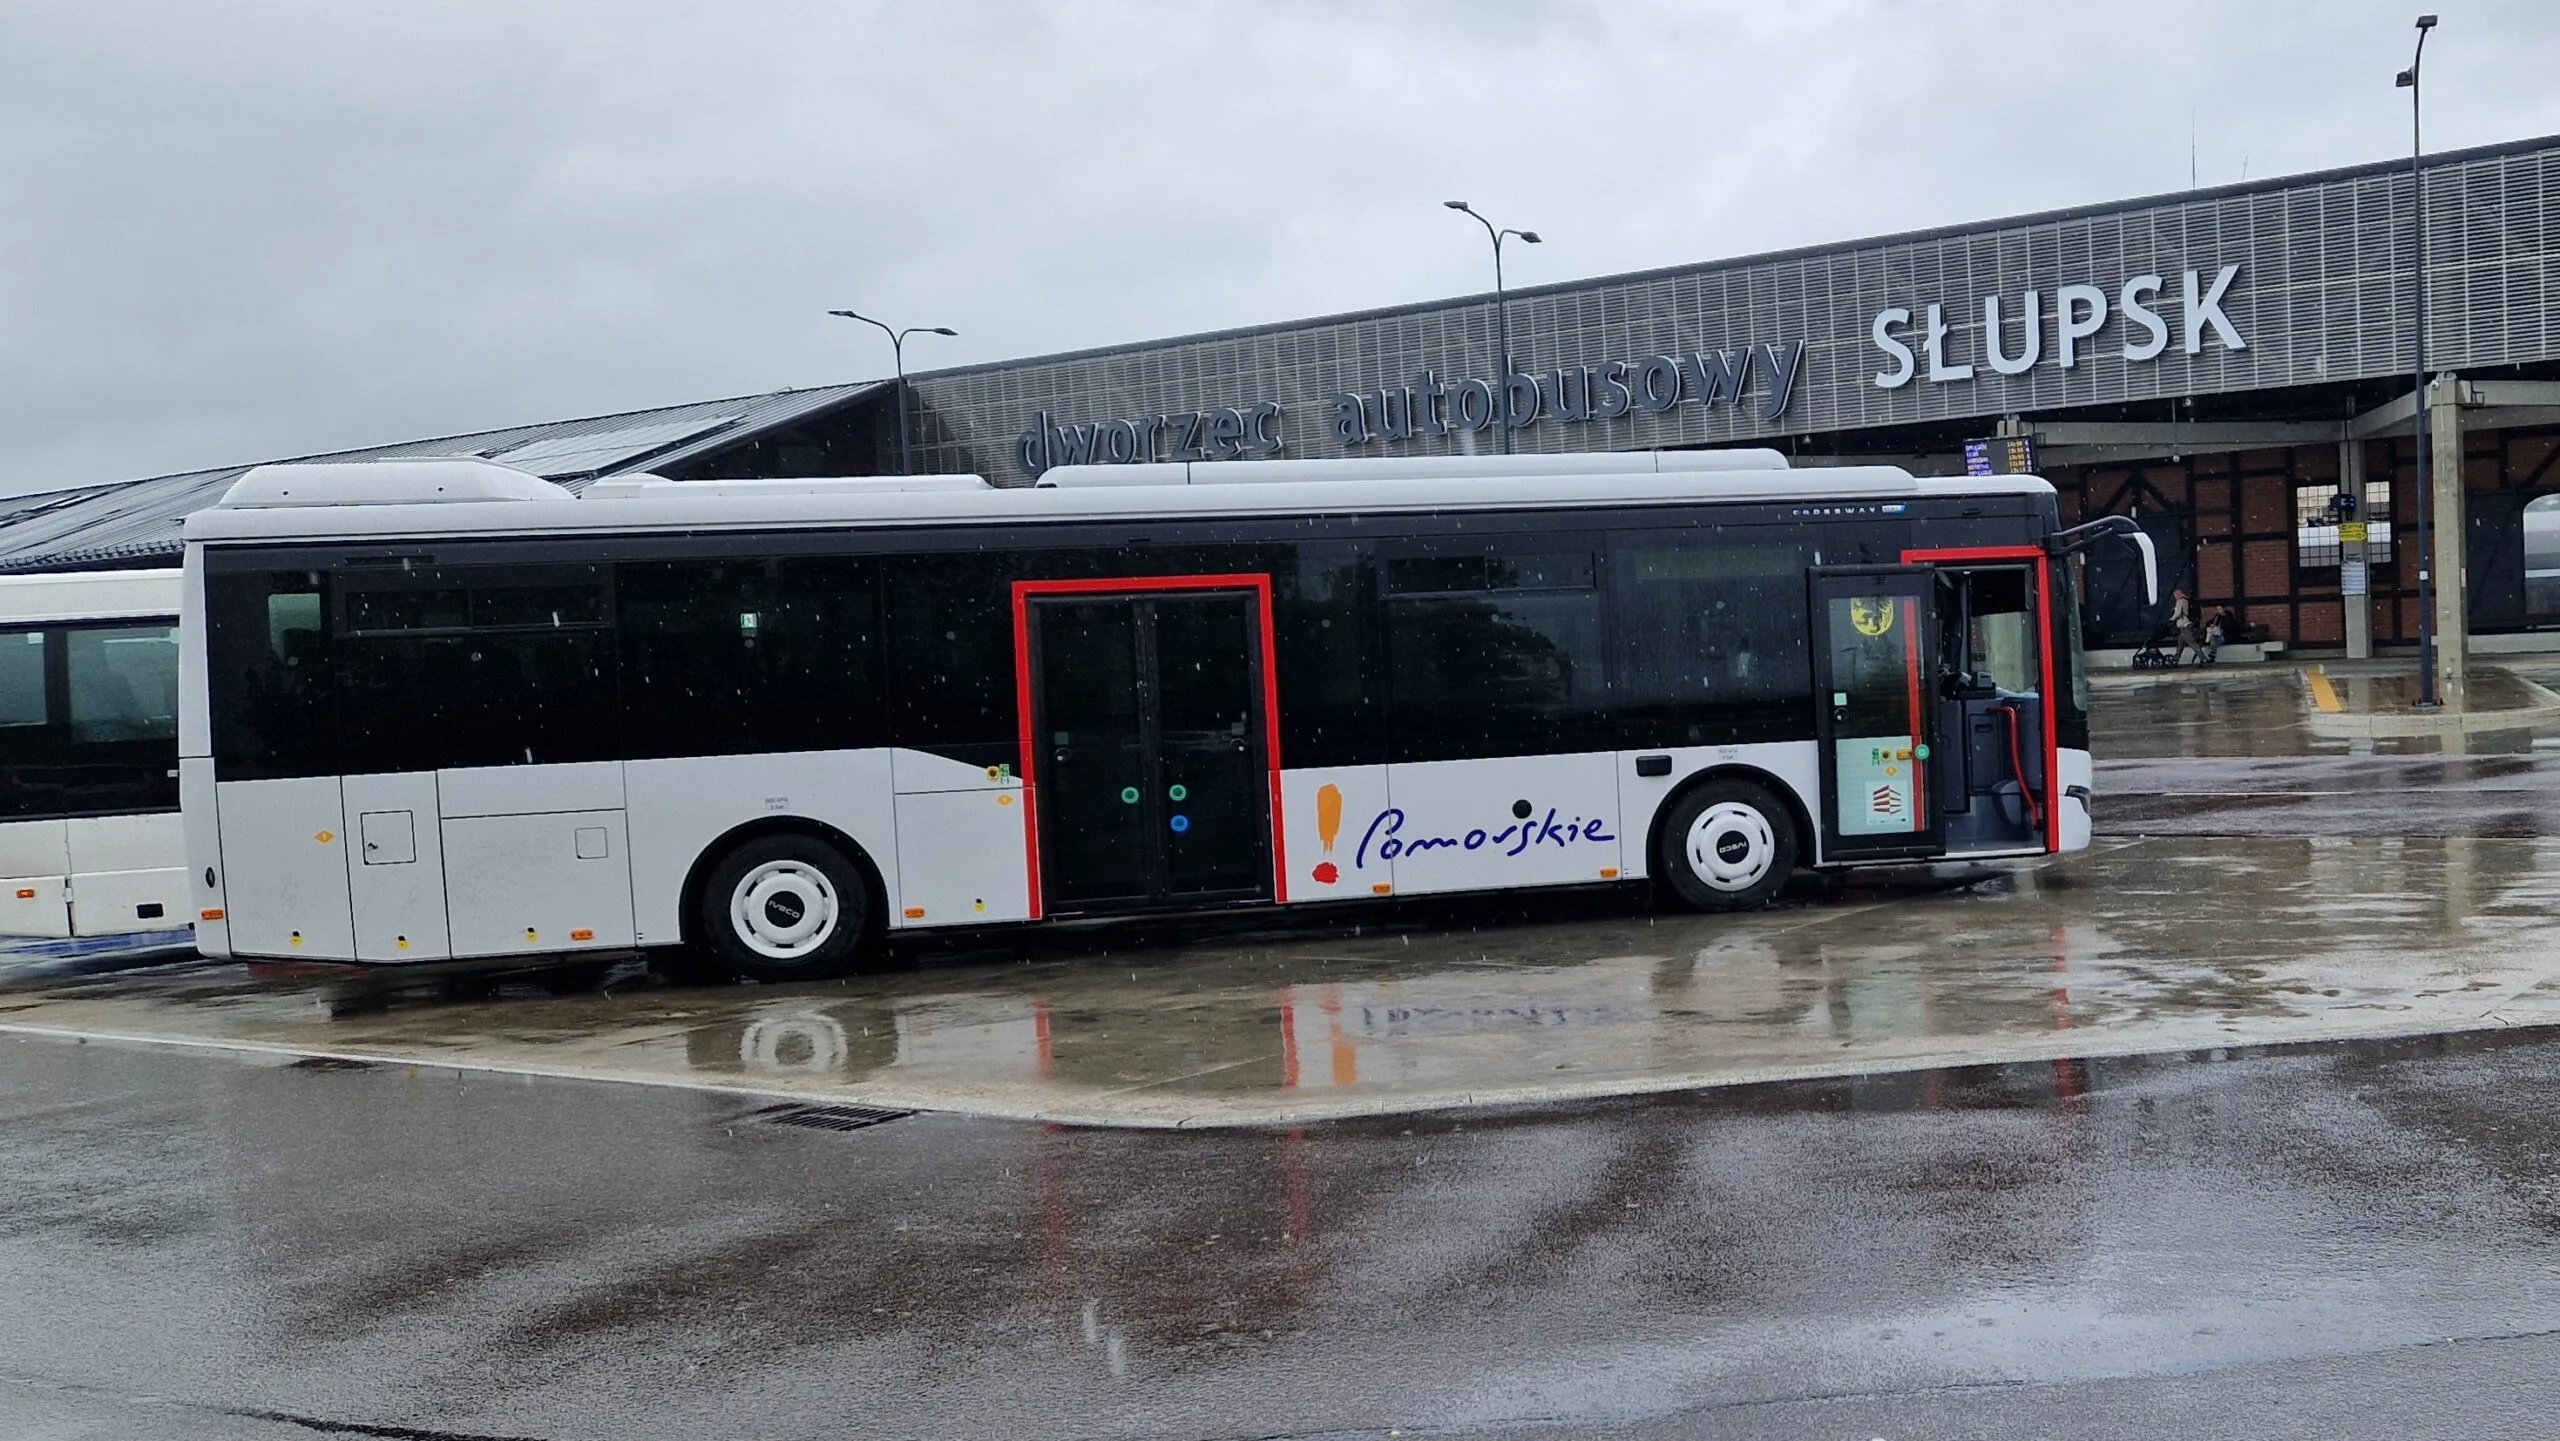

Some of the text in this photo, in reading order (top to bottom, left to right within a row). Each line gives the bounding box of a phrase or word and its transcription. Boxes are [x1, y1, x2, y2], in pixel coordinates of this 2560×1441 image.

[1016, 264, 2247, 477] dworzec autobusowy SŁUPSK
[1356, 807, 1615, 869] Pomorskie
